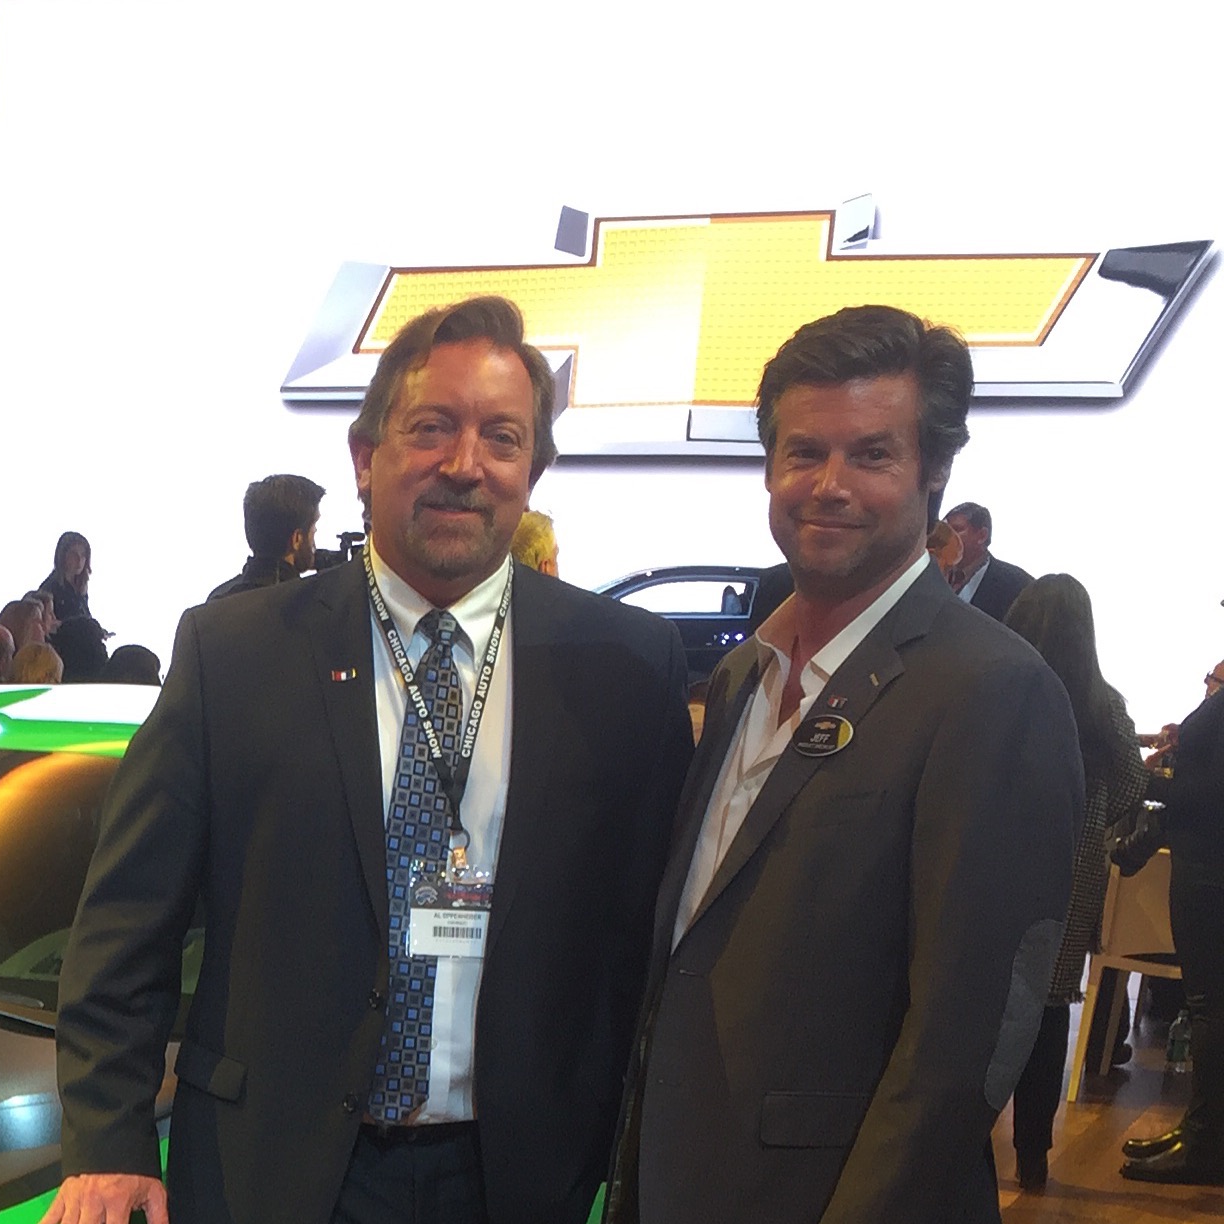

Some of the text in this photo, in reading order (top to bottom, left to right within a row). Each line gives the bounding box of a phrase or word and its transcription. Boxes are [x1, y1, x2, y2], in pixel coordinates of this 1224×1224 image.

[363, 556, 375, 586] AUTO
[370, 586, 389, 621] SHOW
[387, 630, 413, 682] CHICAGO
[408, 685, 428, 718] AUTO
[422, 721, 443, 759] SHOW
[461, 699, 483, 758] CHICAGO
[476, 665, 492, 700] AUTO
[486, 627, 501, 664] SHOW
[810, 733, 831, 743] JEFF
